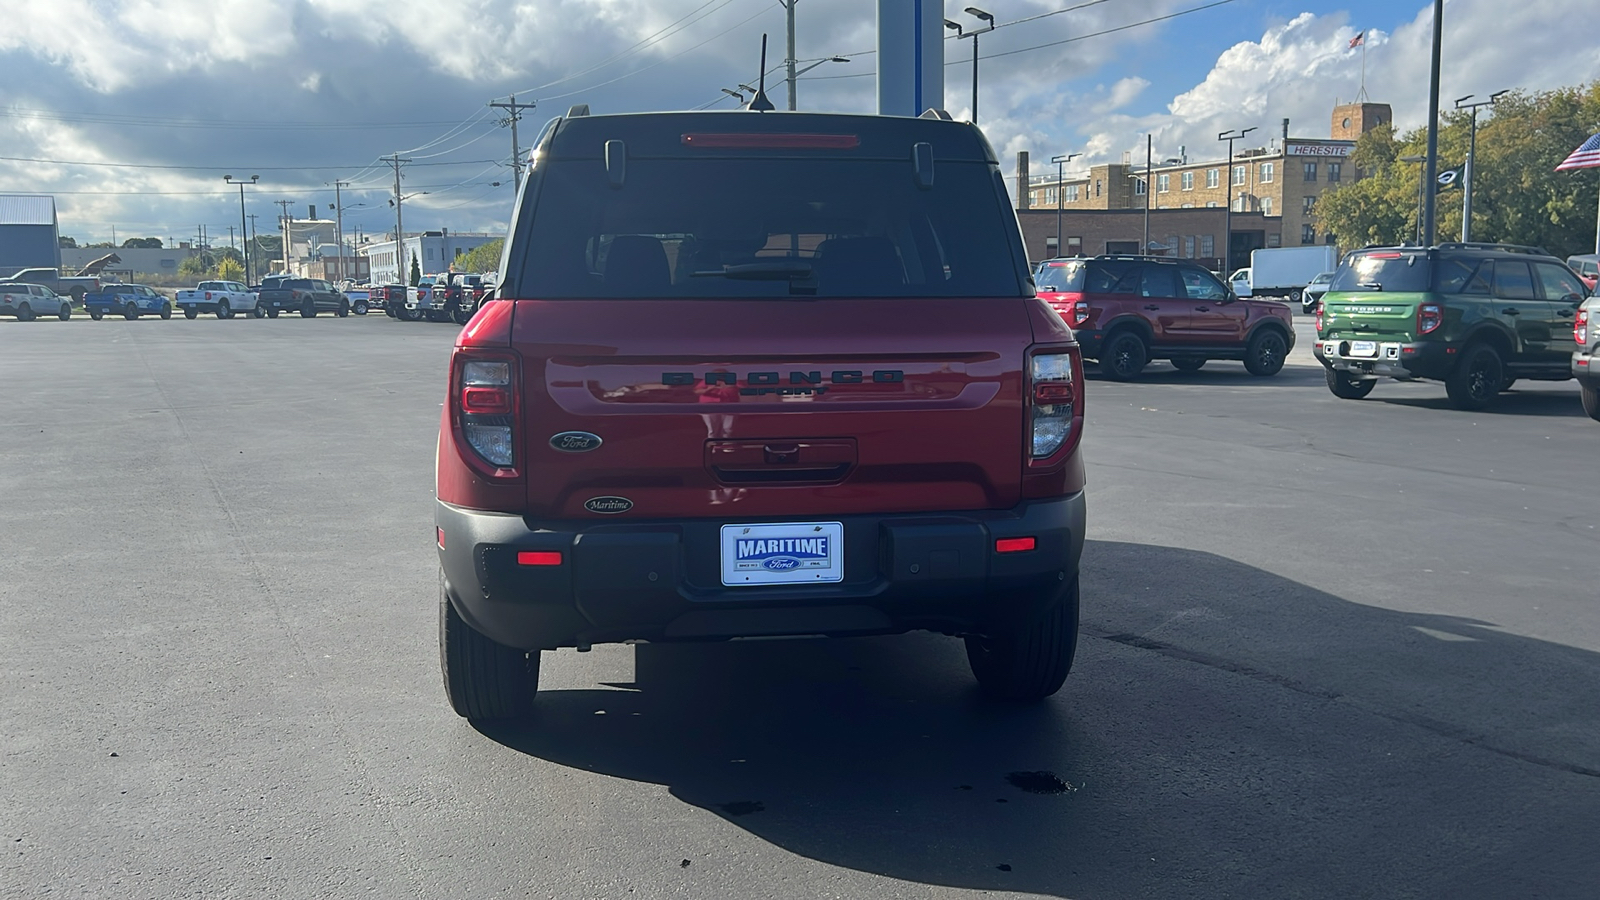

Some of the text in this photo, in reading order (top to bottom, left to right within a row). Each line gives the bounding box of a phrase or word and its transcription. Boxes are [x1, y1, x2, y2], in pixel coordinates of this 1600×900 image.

[1294, 145, 1347, 155] HERESITE
[662, 370, 904, 386] BRONCO
[739, 387, 829, 396] SPORT
[561, 435, 590, 448] Ford
[590, 500, 629, 510] Maritime
[738, 538, 827, 559] MARITIME
[768, 560, 794, 569] Ford
